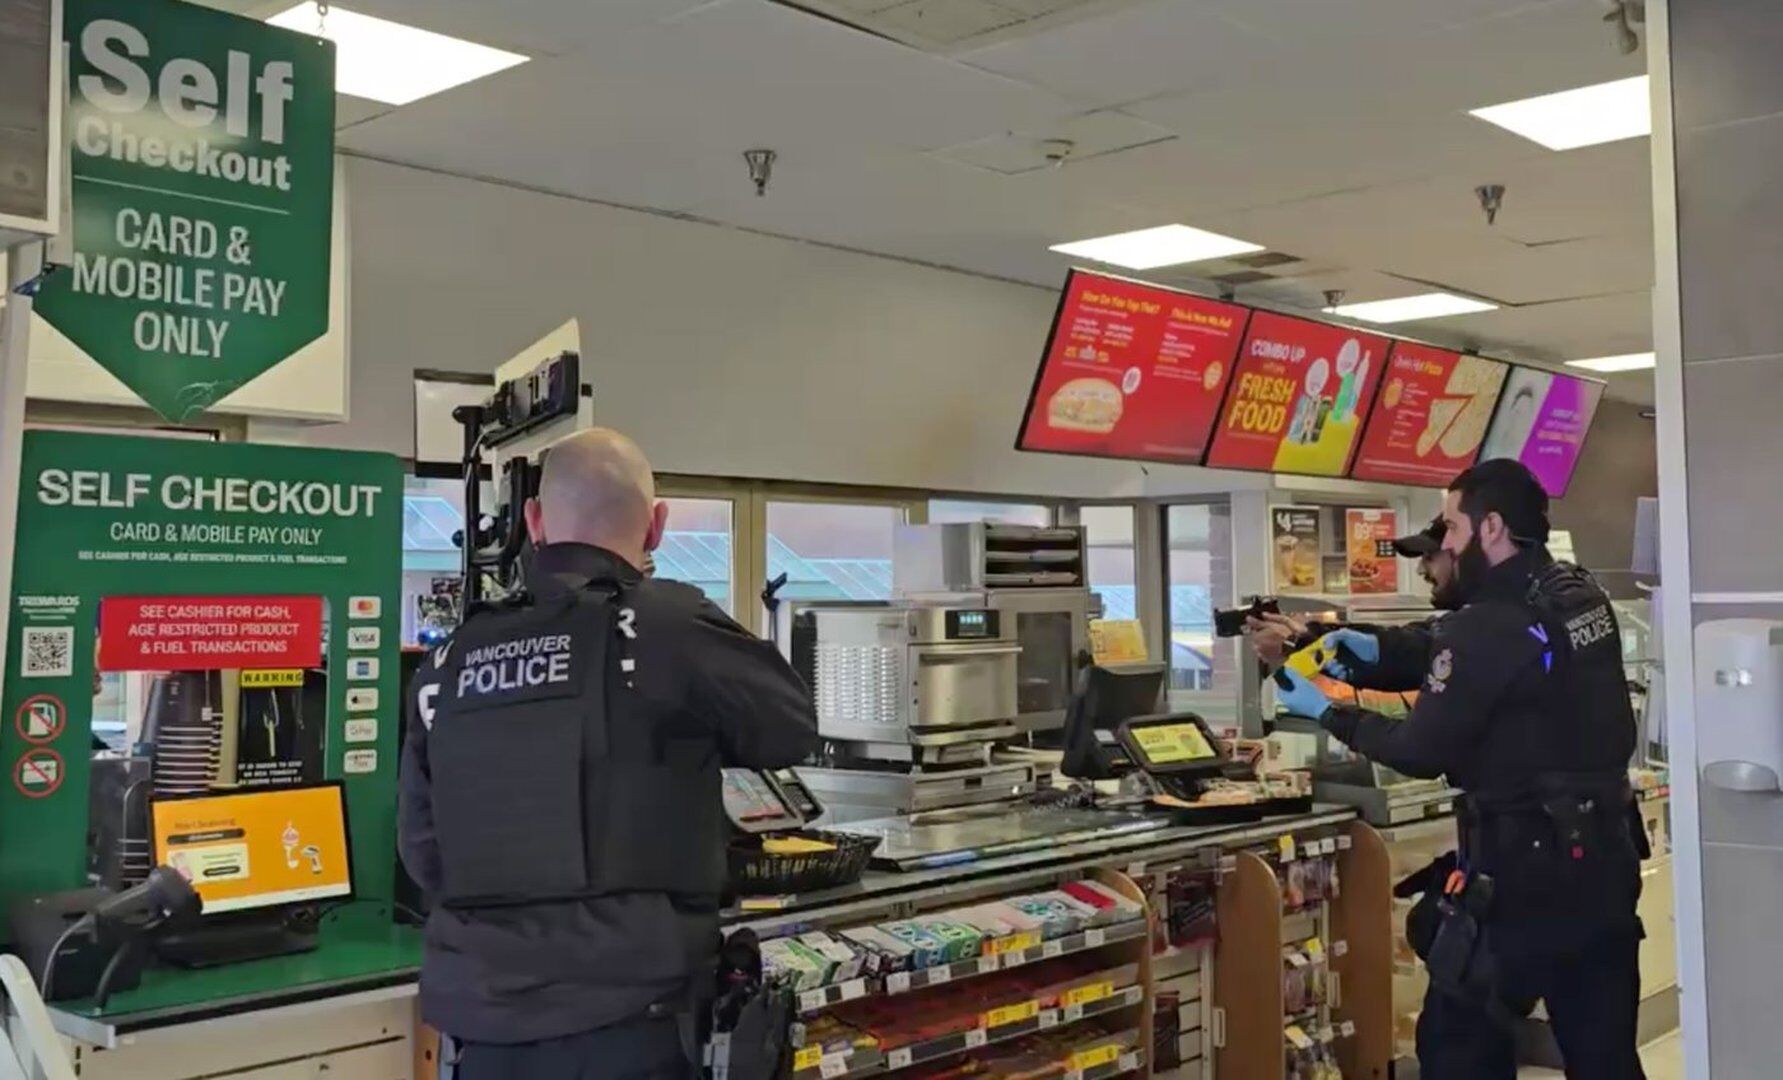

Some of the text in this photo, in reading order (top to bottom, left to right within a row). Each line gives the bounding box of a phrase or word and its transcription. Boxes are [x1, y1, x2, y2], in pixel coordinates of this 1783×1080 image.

[78, 18, 294, 144] Self
[76, 116, 291, 191] Checkout
[116, 208, 251, 265] CARD &
[72, 253, 286, 317] MOBILE PAY
[134, 311, 229, 358] ONLY
[1251, 339, 1306, 362] COMBO UP
[1237, 372, 1297, 404] FRESH
[1228, 401, 1287, 434] FOOD
[37, 469, 382, 517] SELF CHECKOUT
[110, 522, 323, 546] CARD & MOBILE PAY ONLY
[139, 605, 165, 618] SEE
[167, 605, 224, 618] CASHIER
[226, 605, 252, 618] FOR
[128, 623, 299, 636] AGE RESTRICTED PRODUCT
[1570, 615, 1613, 650] POLICE
[140, 641, 287, 654] & FUEL TRANSACTIONS
[465, 635, 571, 666] VANCOUVER
[457, 653, 571, 698] POLICE
